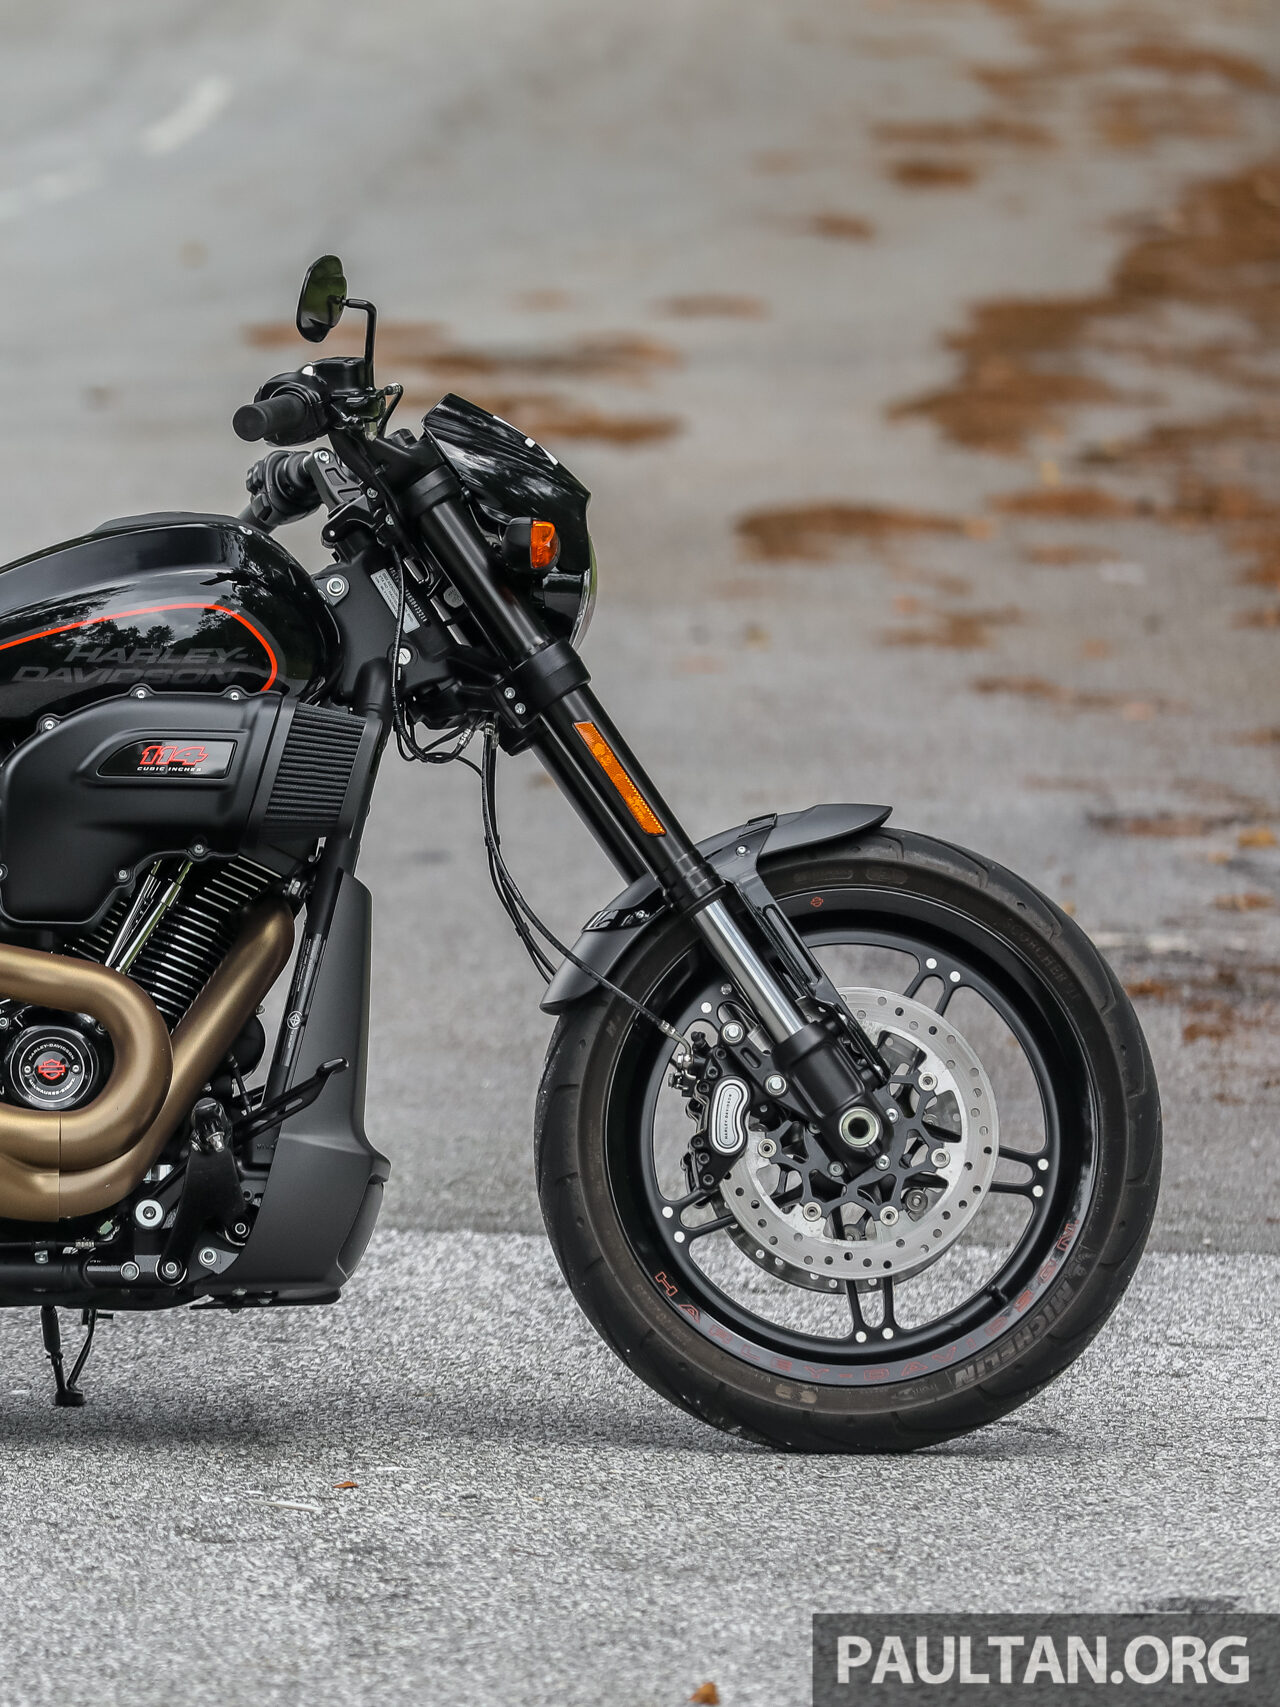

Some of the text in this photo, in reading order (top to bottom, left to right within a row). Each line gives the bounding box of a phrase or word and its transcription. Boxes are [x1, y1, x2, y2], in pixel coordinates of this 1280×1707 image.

[64, 647, 249, 664] HARLEY-
[11, 666, 236, 683] DAVIDSON
[140, 746, 208, 766] 114
[28, 1043, 75, 1061] HARLEY-DAVIDSON
[952, 1279, 1076, 1388] MICHELIN
